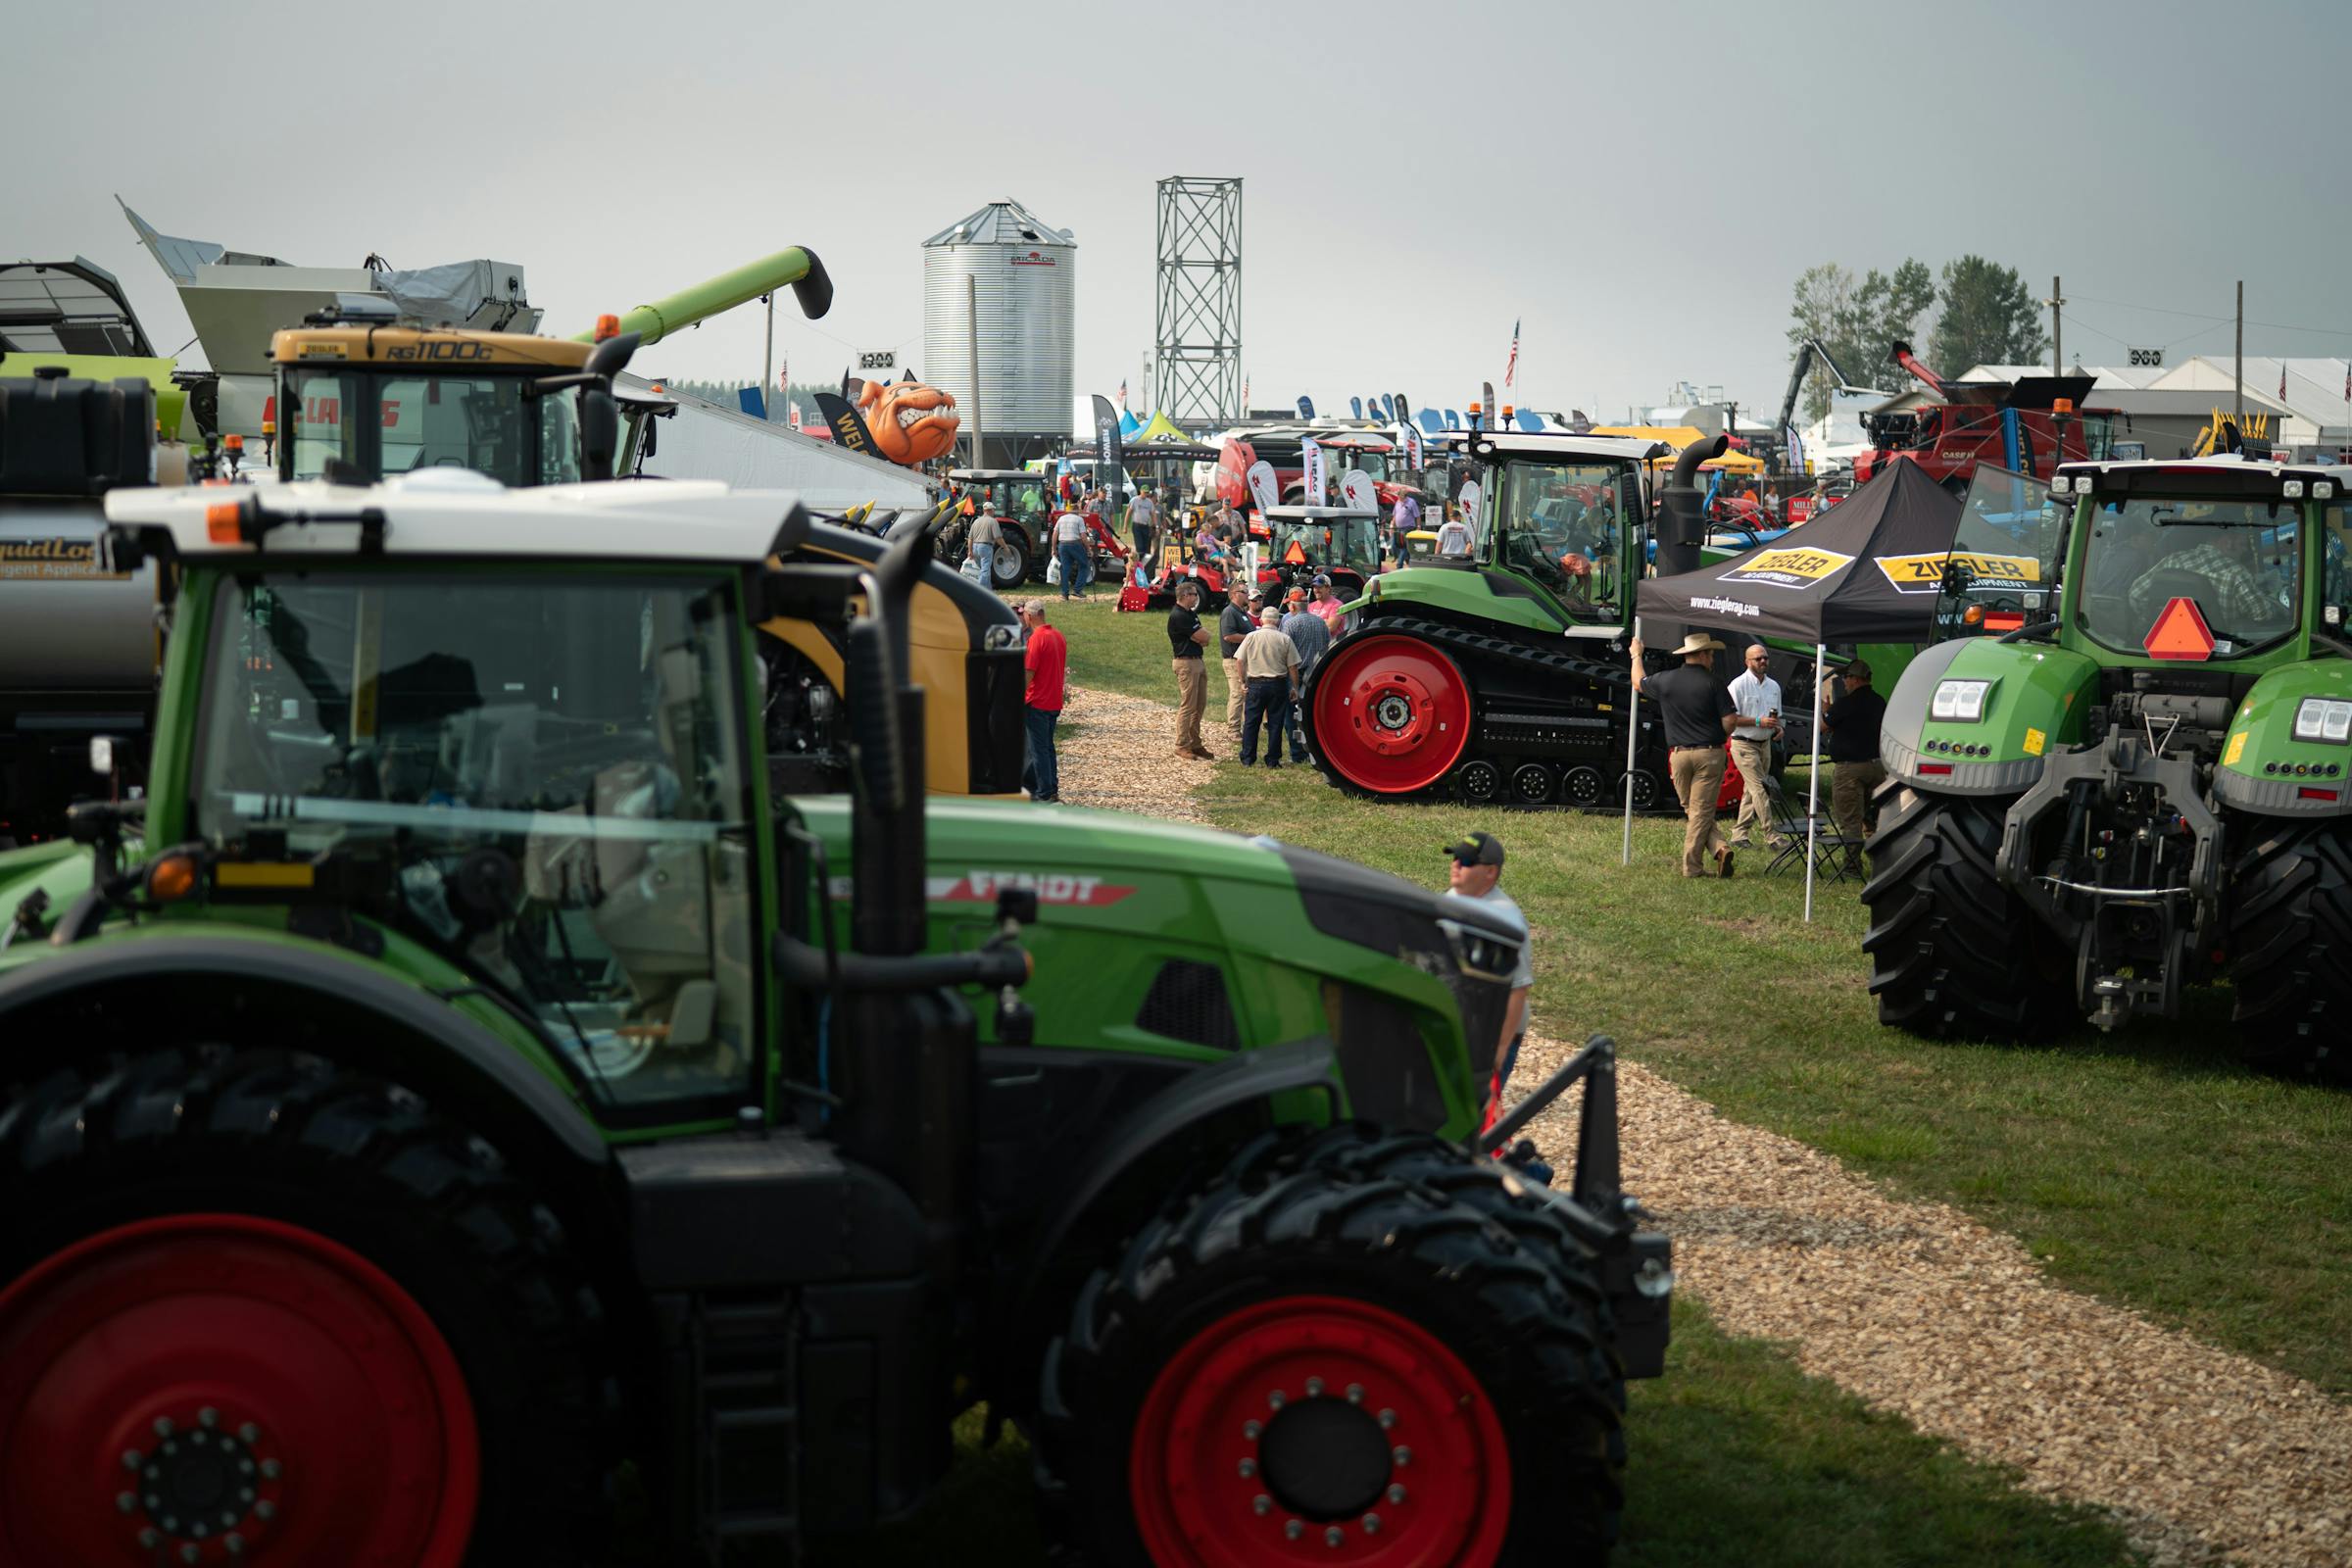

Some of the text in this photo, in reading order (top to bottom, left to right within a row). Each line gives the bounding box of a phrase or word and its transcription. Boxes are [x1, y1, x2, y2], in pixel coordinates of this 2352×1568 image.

[2131, 350, 2161, 366] 900
[263, 396, 400, 426] LAS
[1757, 553, 1829, 573] ZIEGLER
[1754, 571, 1801, 583] EQUIPMENT
[1967, 578, 2028, 588] UIPMENT
[1690, 595, 1760, 616] www.zieglerag.com
